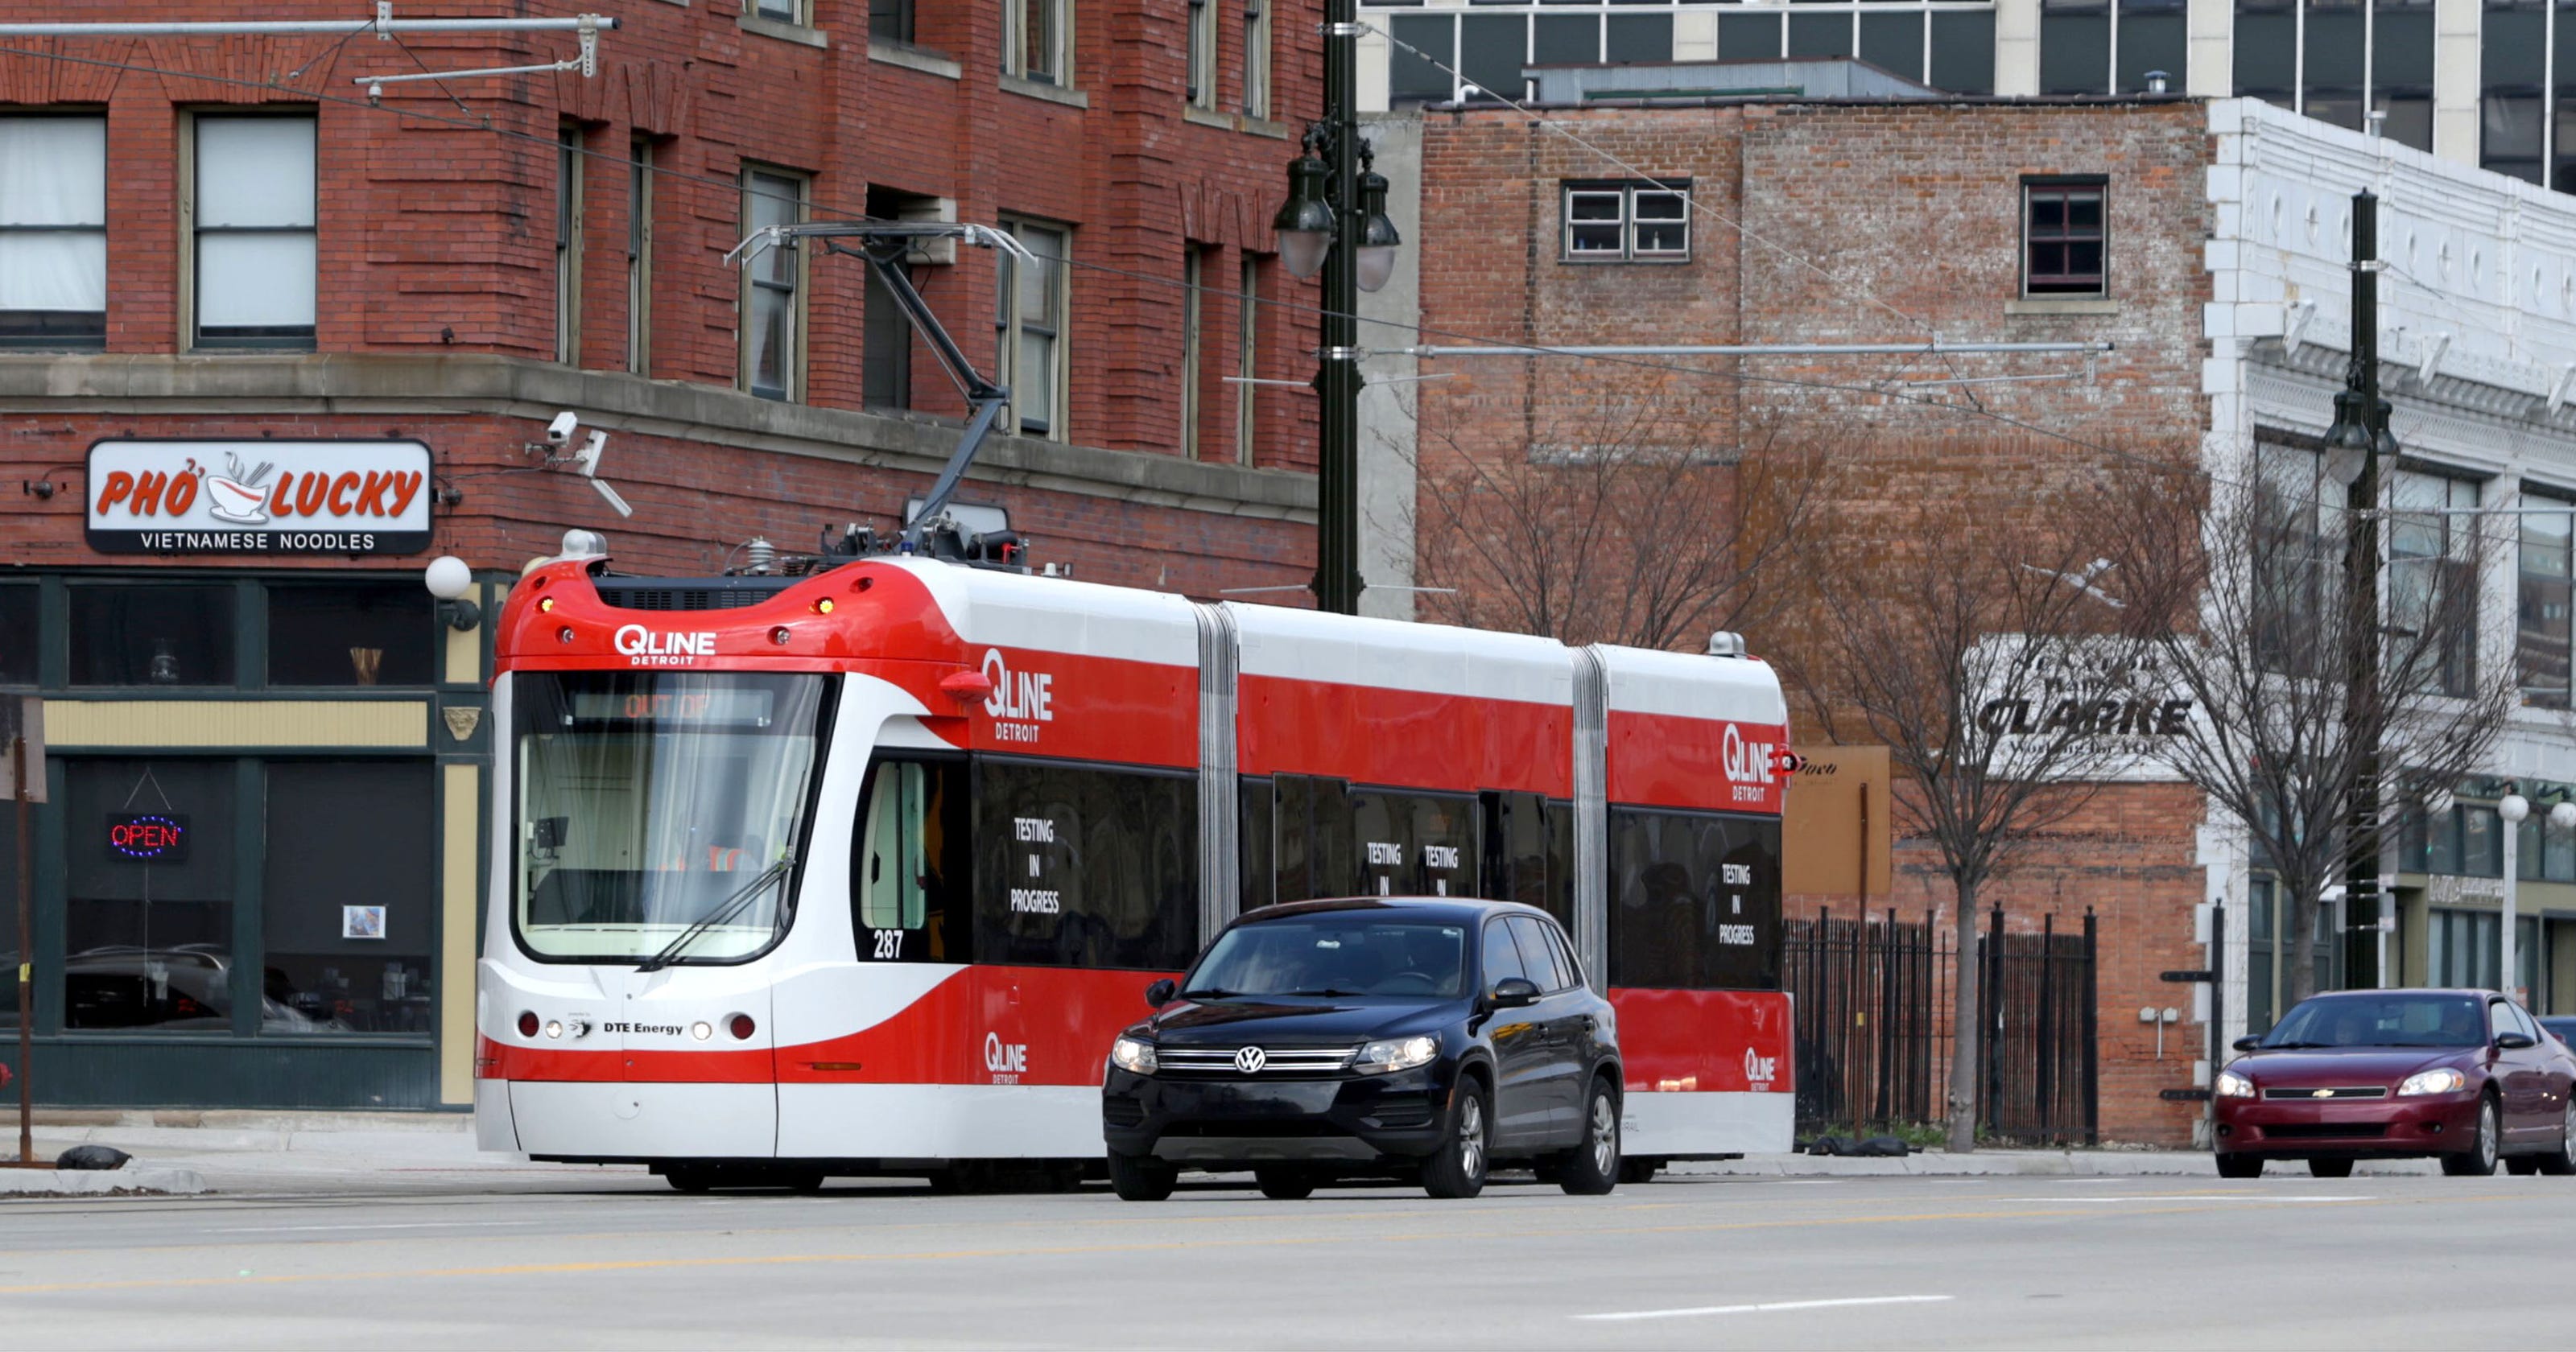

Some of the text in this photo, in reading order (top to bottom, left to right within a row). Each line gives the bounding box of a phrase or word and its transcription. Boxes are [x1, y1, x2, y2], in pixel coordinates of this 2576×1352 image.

[270, 471, 423, 517] LUCKY
[141, 533, 375, 550] VIETNAMESE NOODLES
[614, 624, 716, 655] QLINE
[631, 656, 694, 666] DETROIT
[982, 648, 1053, 721] QLINE
[625, 694, 671, 718] OUT
[1977, 698, 2193, 735] CLARKE
[996, 722, 1039, 743] DETROIT
[1723, 723, 1774, 784] QLINE
[1732, 785, 1765, 802] DETROIT
[111, 824, 179, 847] OPEN
[1014, 817, 1054, 843] TESTING
[1367, 842, 1402, 865] TESTING
[1425, 846, 1459, 868] TESTING
[1029, 854, 1040, 877] IN
[1722, 864, 1751, 885] TESTING
[1380, 876, 1389, 897] IN
[1437, 879, 1447, 897] IN
[1011, 888, 1059, 914] PROGRESS
[1732, 894, 1740, 914] IN
[873, 929, 903, 958] 287
[1719, 924, 1754, 945] PROGRESS
[604, 1022, 683, 1036] DTE Energy
[985, 1032, 1027, 1073] QLINE
[1745, 1046, 1776, 1081] QLINE
[993, 1074, 1018, 1084] DETROIT
